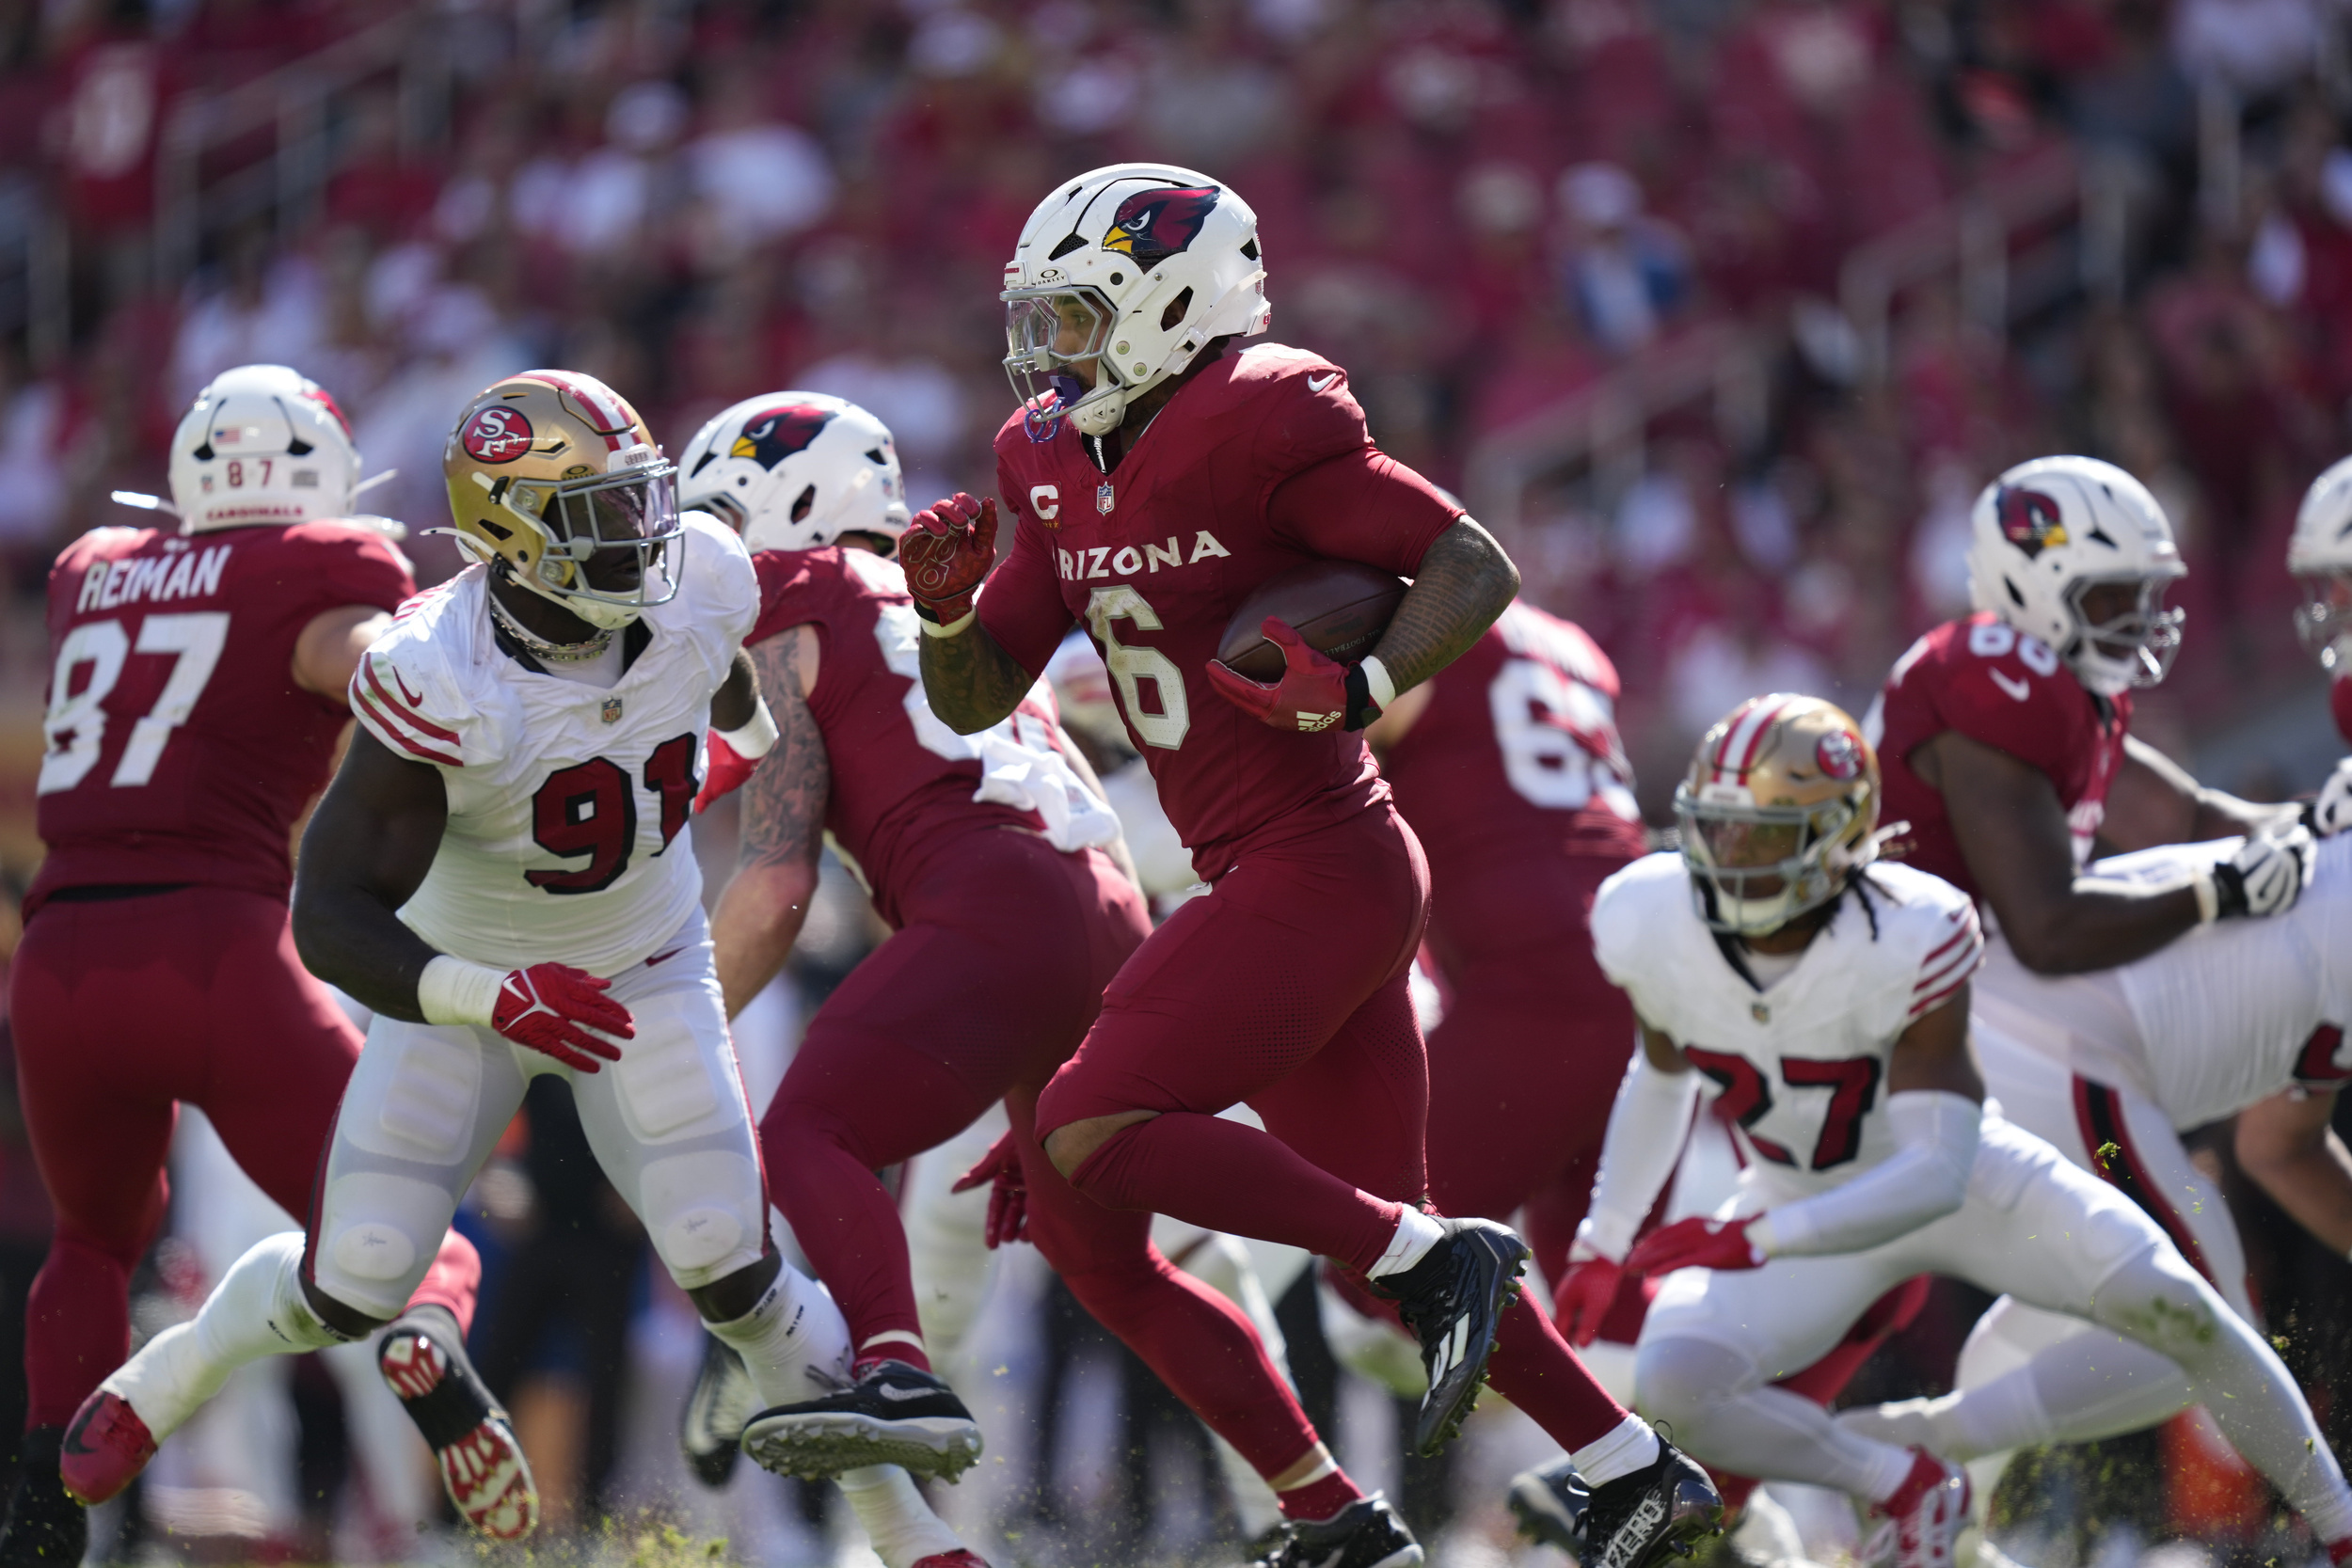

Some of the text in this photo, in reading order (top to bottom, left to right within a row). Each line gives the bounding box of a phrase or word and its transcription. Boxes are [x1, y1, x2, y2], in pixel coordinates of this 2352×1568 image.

[1037, 275, 1067, 286] OAKLEY
[206, 503, 304, 521] CARDINALS
[1029, 484, 1058, 520] C
[1099, 497, 1111, 510] NFL
[76, 543, 233, 615] REIMAN
[1053, 530, 1232, 581] RIZONA
[1084, 583, 1191, 752] 6
[1324, 635, 1367, 657] FOOTBALL
[36, 611, 231, 799] 87
[523, 731, 700, 895] 91
[1683, 1044, 1883, 1173] 27
